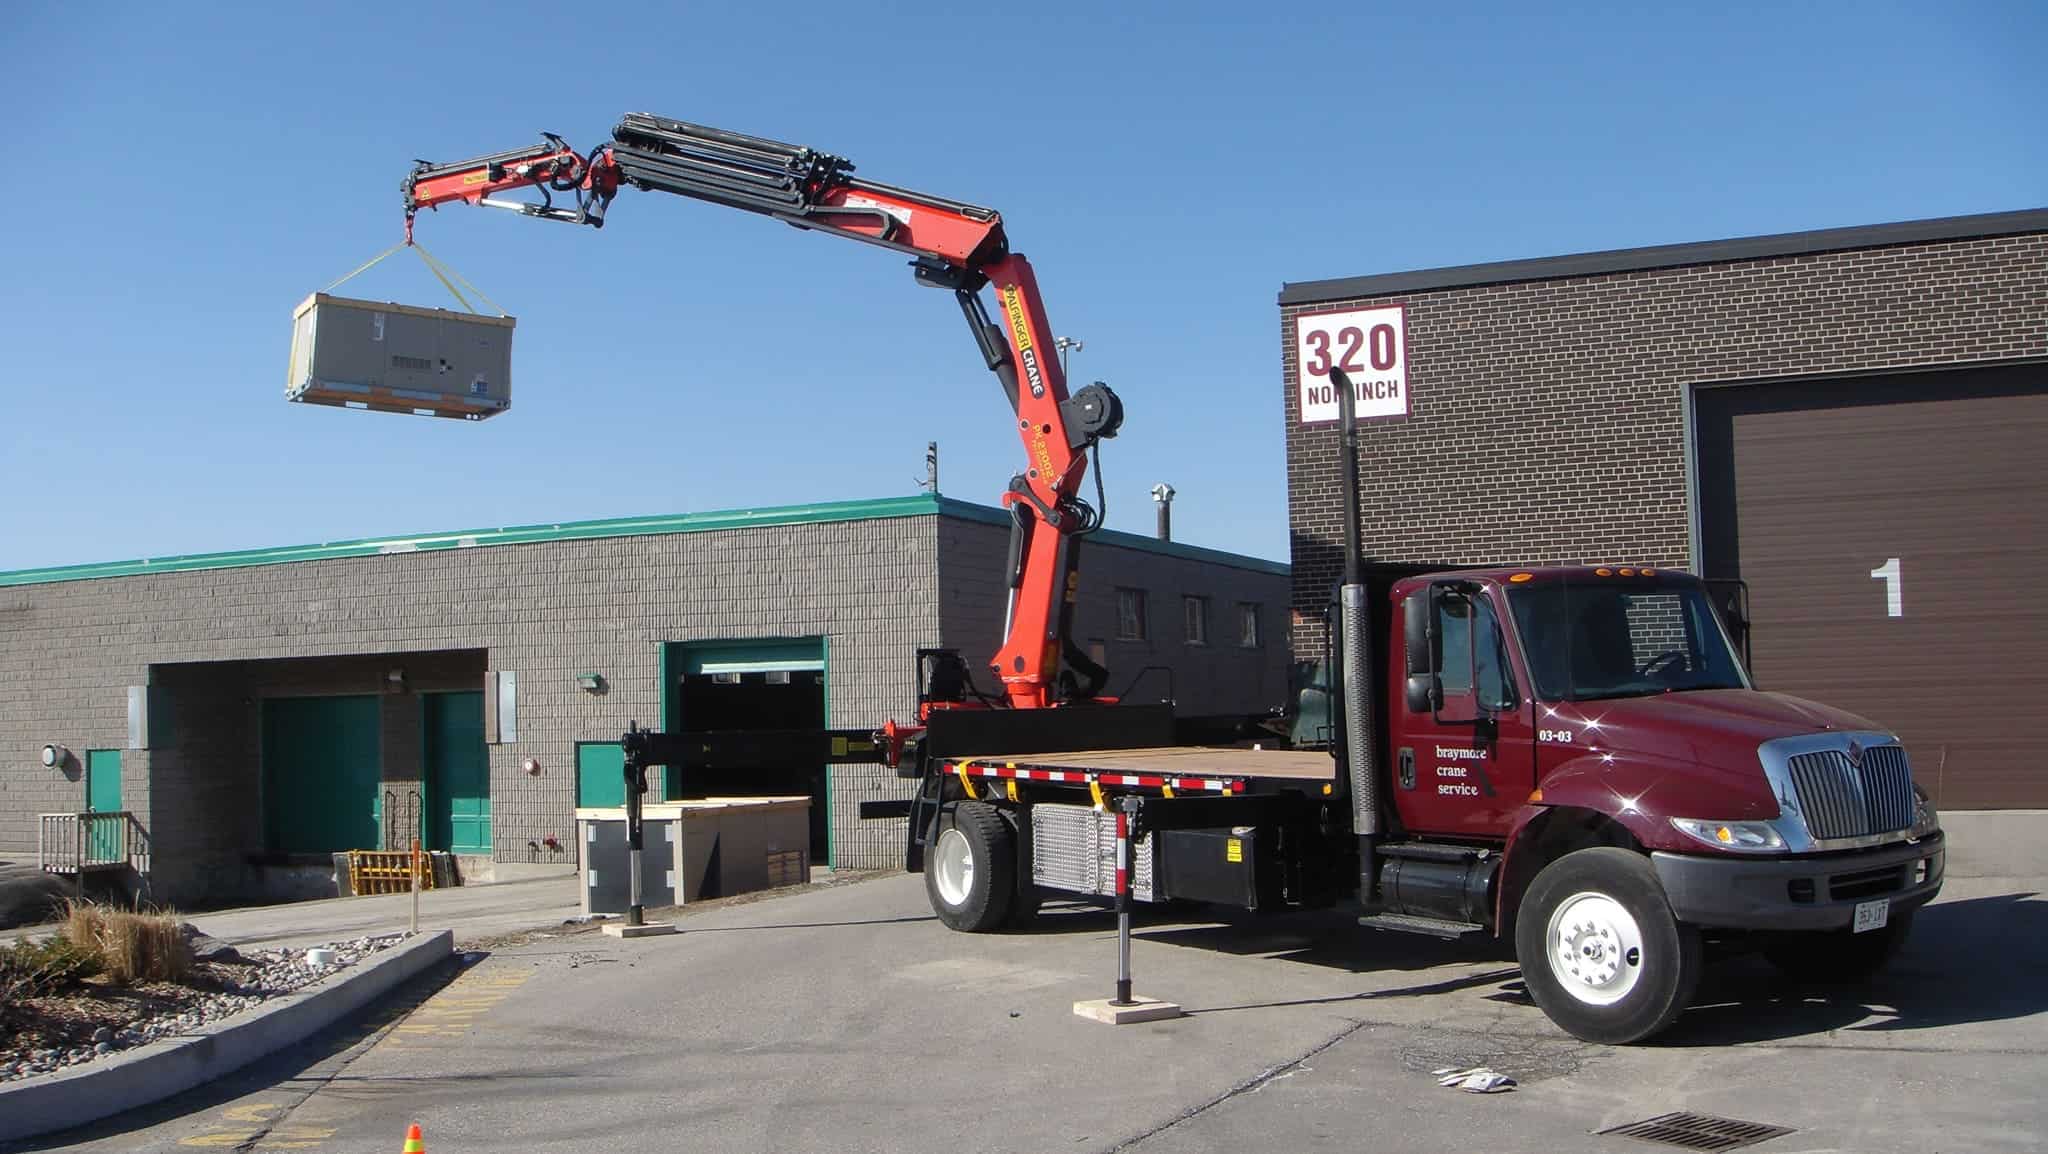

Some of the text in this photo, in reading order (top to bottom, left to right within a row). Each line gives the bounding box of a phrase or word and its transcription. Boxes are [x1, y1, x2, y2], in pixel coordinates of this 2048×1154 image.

[1004, 286, 1044, 396] PALFINGER CRANE
[1305, 323, 1396, 376] 320
[1871, 557, 1903, 617] 1
[1539, 729, 1572, 742] 03-03
[1435, 744, 1487, 761] braymore
[1436, 766, 1467, 777] crane
[1437, 782, 1479, 796] service
